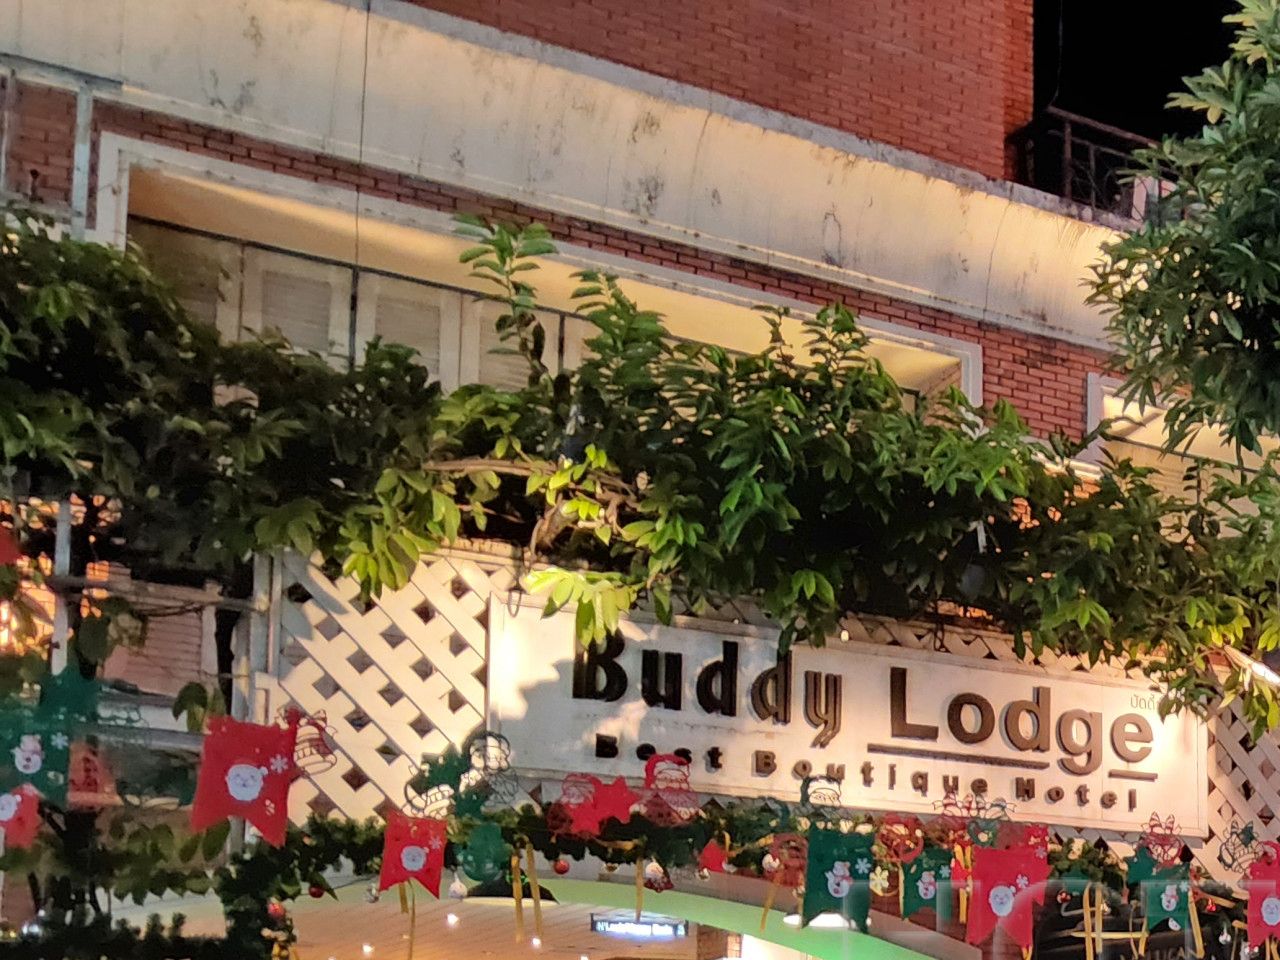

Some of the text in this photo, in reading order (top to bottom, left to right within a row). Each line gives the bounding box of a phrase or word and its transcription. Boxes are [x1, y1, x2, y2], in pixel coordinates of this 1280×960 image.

[572, 630, 1154, 777] Buddy Lodge
[752, 749, 989, 799] Boutique
[1015, 776, 1138, 813] Hotel
